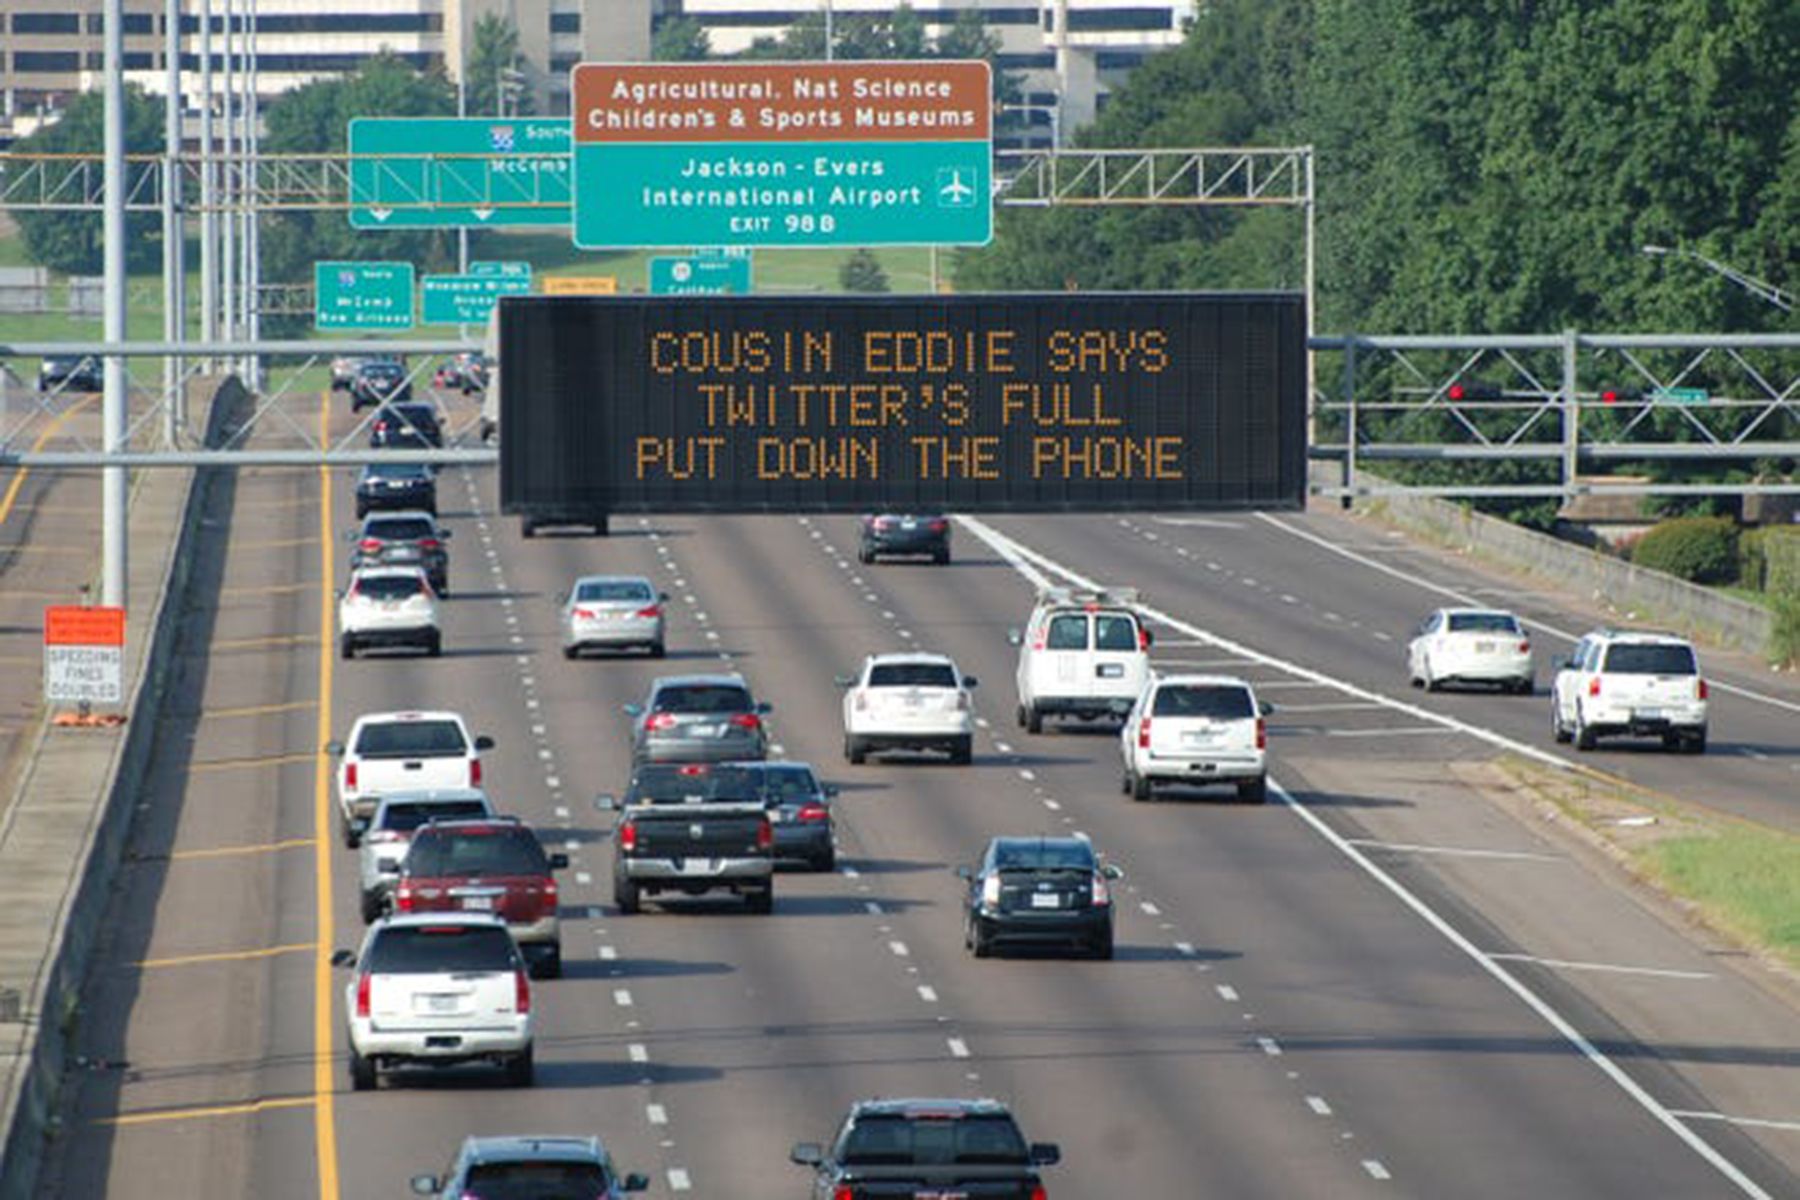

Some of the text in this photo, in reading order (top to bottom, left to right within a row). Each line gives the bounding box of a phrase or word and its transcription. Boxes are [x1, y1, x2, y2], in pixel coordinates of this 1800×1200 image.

[793, 79, 838, 98] Nat
[853, 78, 952, 98] Science
[588, 107, 975, 131] Children's & Sports Museums
[680, 157, 787, 178] Jackson
[813, 157, 885, 176] Evers
[642, 186, 922, 209] International Airport
[729, 217, 770, 232] EXIT
[650, 330, 1169, 373] COUSIN EDDIE SAYS
[698, 384, 1122, 427] TWITTER'S FULL
[636, 436, 1184, 480] PUT DOWN THE PHONE
